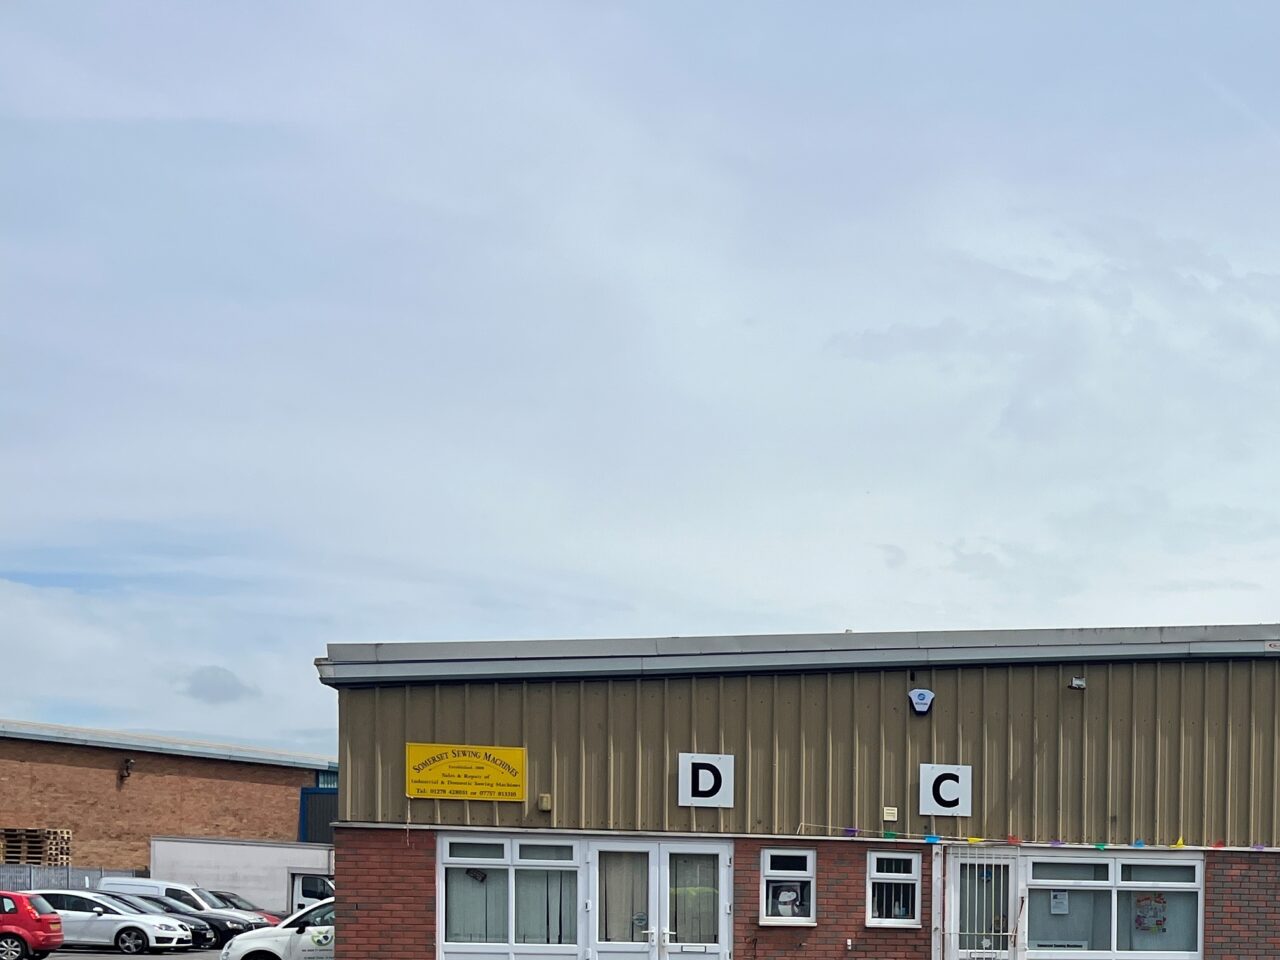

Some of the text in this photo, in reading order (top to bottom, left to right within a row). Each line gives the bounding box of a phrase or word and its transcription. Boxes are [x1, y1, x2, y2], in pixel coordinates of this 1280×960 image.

[412, 749, 519, 778] SOMERSET SEWING MACHINES
[690, 762, 722, 798] D
[932, 773, 960, 808] C
